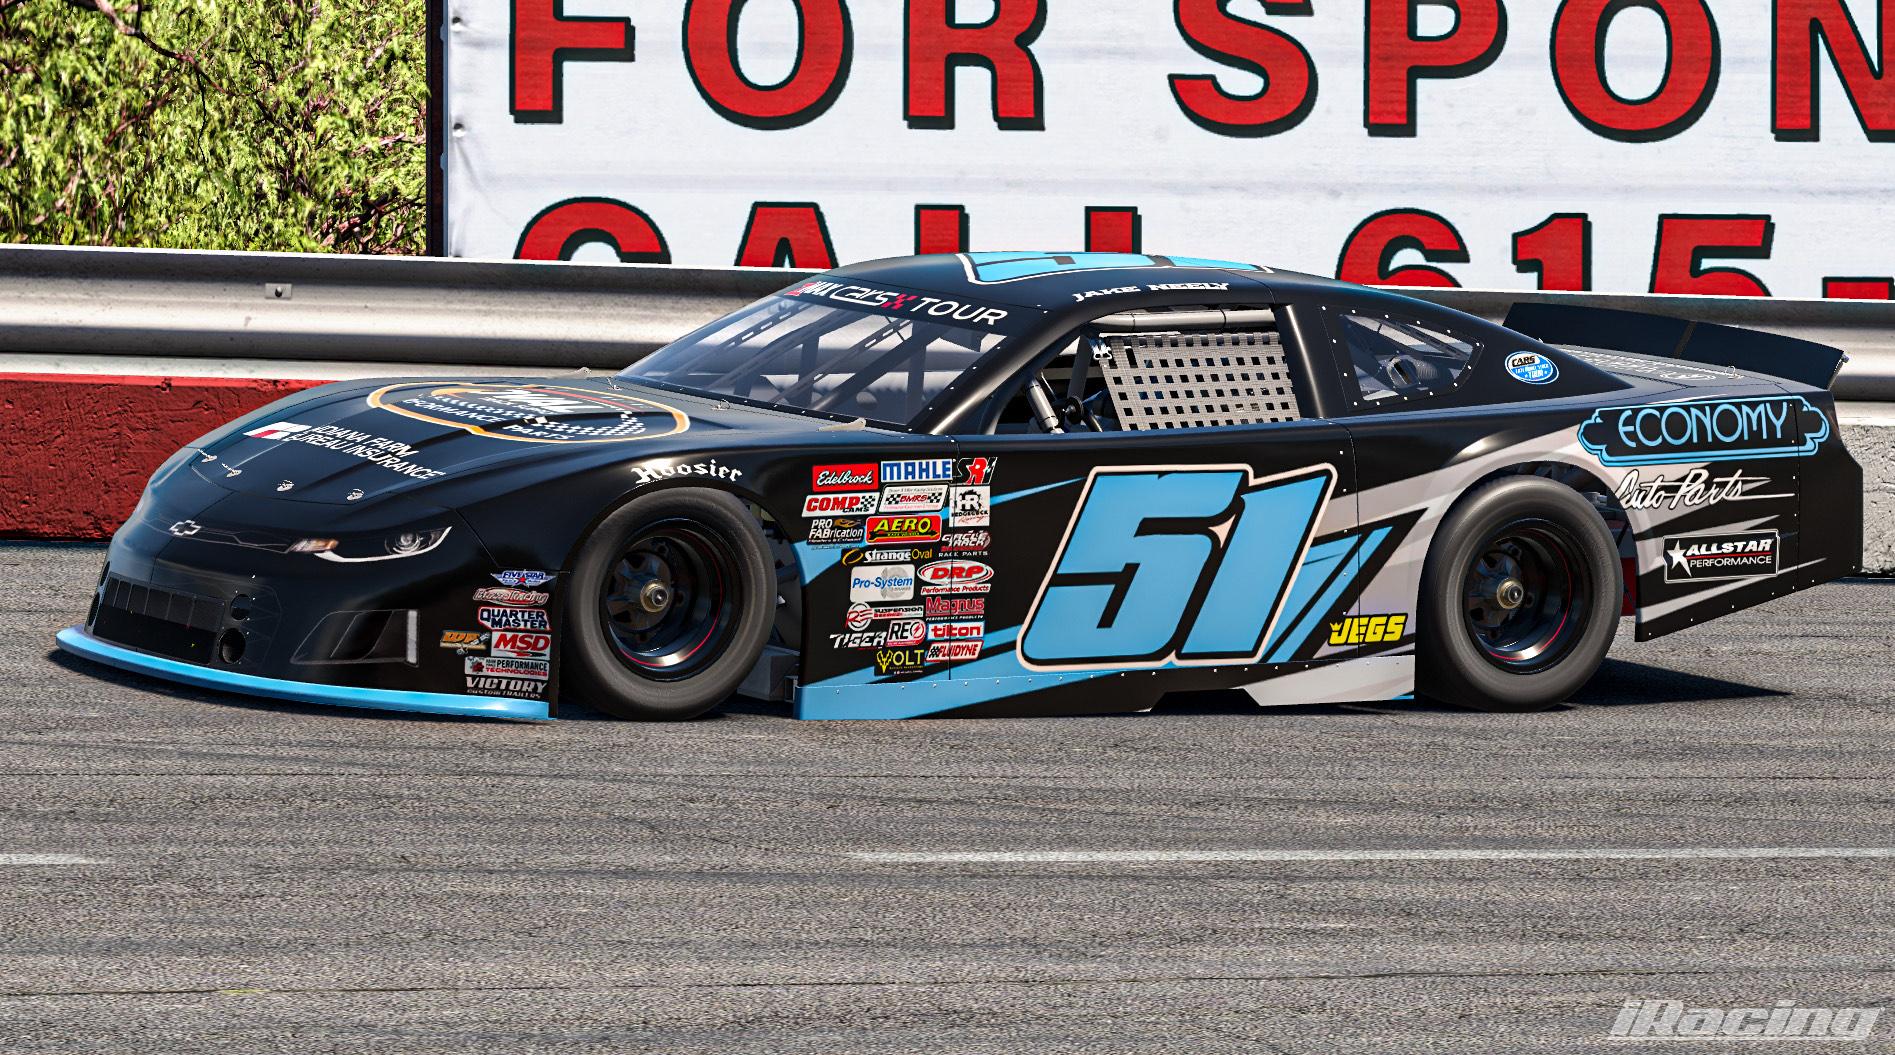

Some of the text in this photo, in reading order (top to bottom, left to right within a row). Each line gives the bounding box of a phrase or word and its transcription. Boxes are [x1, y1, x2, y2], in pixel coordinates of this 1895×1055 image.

[509, 0, 1047, 131] FOR
[1072, 282, 1230, 302] JAKE NEELY
[910, 297, 1008, 325] TOUR
[1618, 401, 1788, 448] ECONOMY
[366, 437, 419, 458] FARM
[343, 441, 444, 479] INSURANCE
[631, 459, 742, 484] Hoosier
[817, 470, 873, 486] Edelbrock
[882, 461, 951, 480] MAHLE
[1614, 469, 1768, 510] Auto Parts
[806, 496, 860, 512] COMP
[811, 519, 833, 528] PRO
[873, 518, 931, 533] AERO
[809, 528, 864, 539] FABrication
[864, 549, 911, 563] Strange
[911, 548, 933, 560] Oval
[1686, 538, 1773, 556] ALLSTAR
[1018, 466, 1336, 668] 51
[1690, 555, 1772, 568] PERFORMANCE
[930, 565, 984, 580] DRP
[852, 576, 913, 589] Pro-System
[926, 597, 985, 614] Magnus
[480, 609, 545, 622] QUARTER
[491, 619, 548, 629] MASTER
[1330, 616, 1406, 643] JEGS
[493, 633, 550, 652] MSD
[829, 631, 887, 649] TIGER
[497, 660, 548, 672] PERFORMANCE
[466, 676, 548, 694] VICTORY
